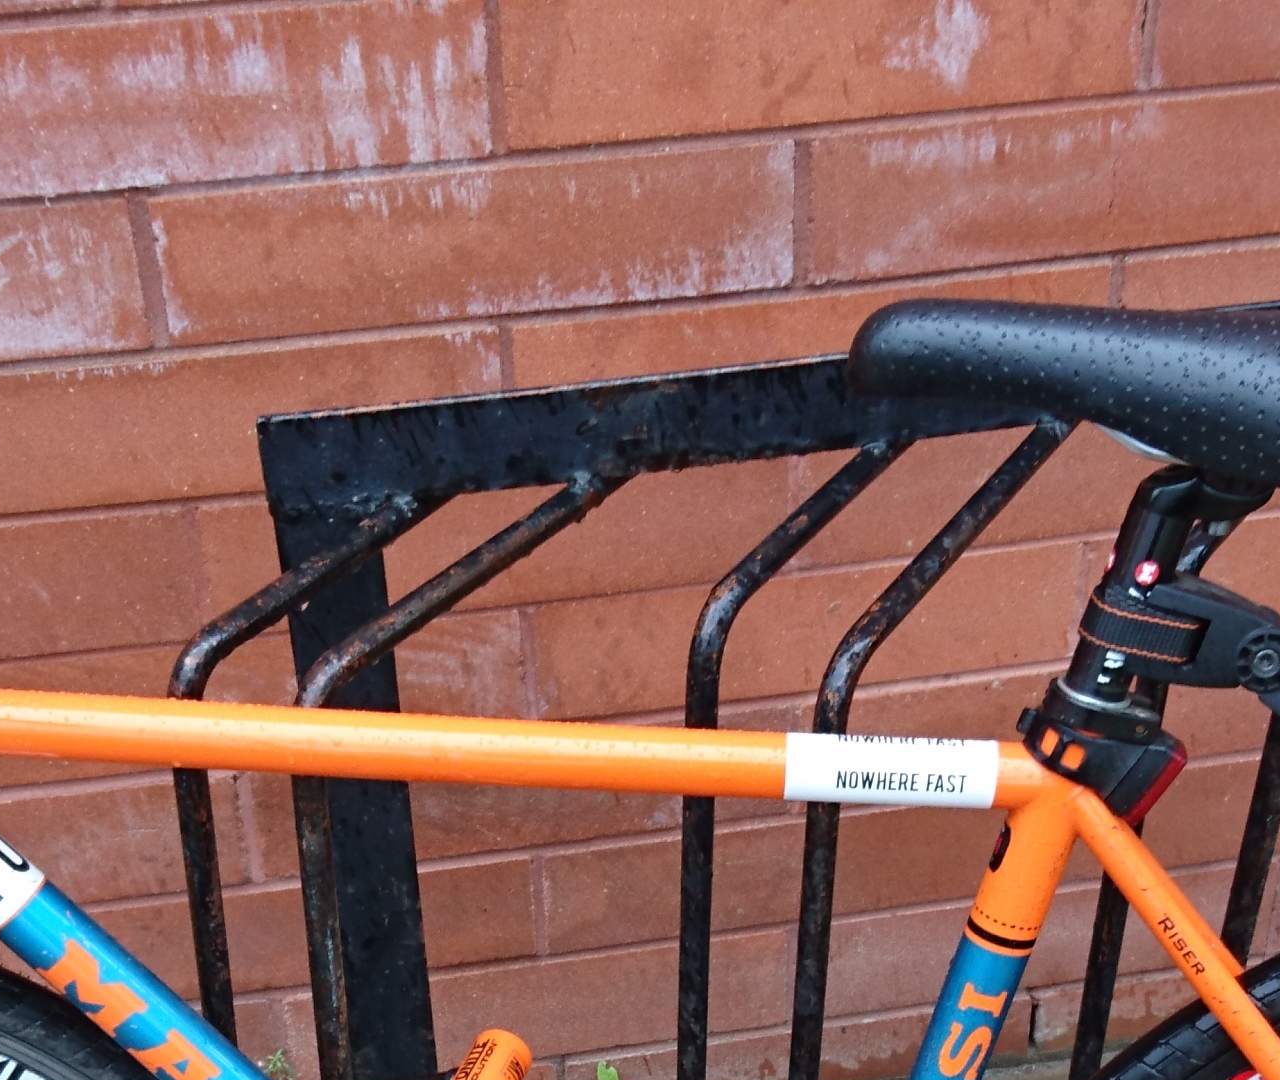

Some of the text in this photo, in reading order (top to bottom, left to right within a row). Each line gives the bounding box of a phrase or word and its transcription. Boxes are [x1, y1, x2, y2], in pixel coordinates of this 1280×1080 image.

[836, 770, 967, 793] NOWHERE FAST
[1158, 915, 1206, 977] RISER
